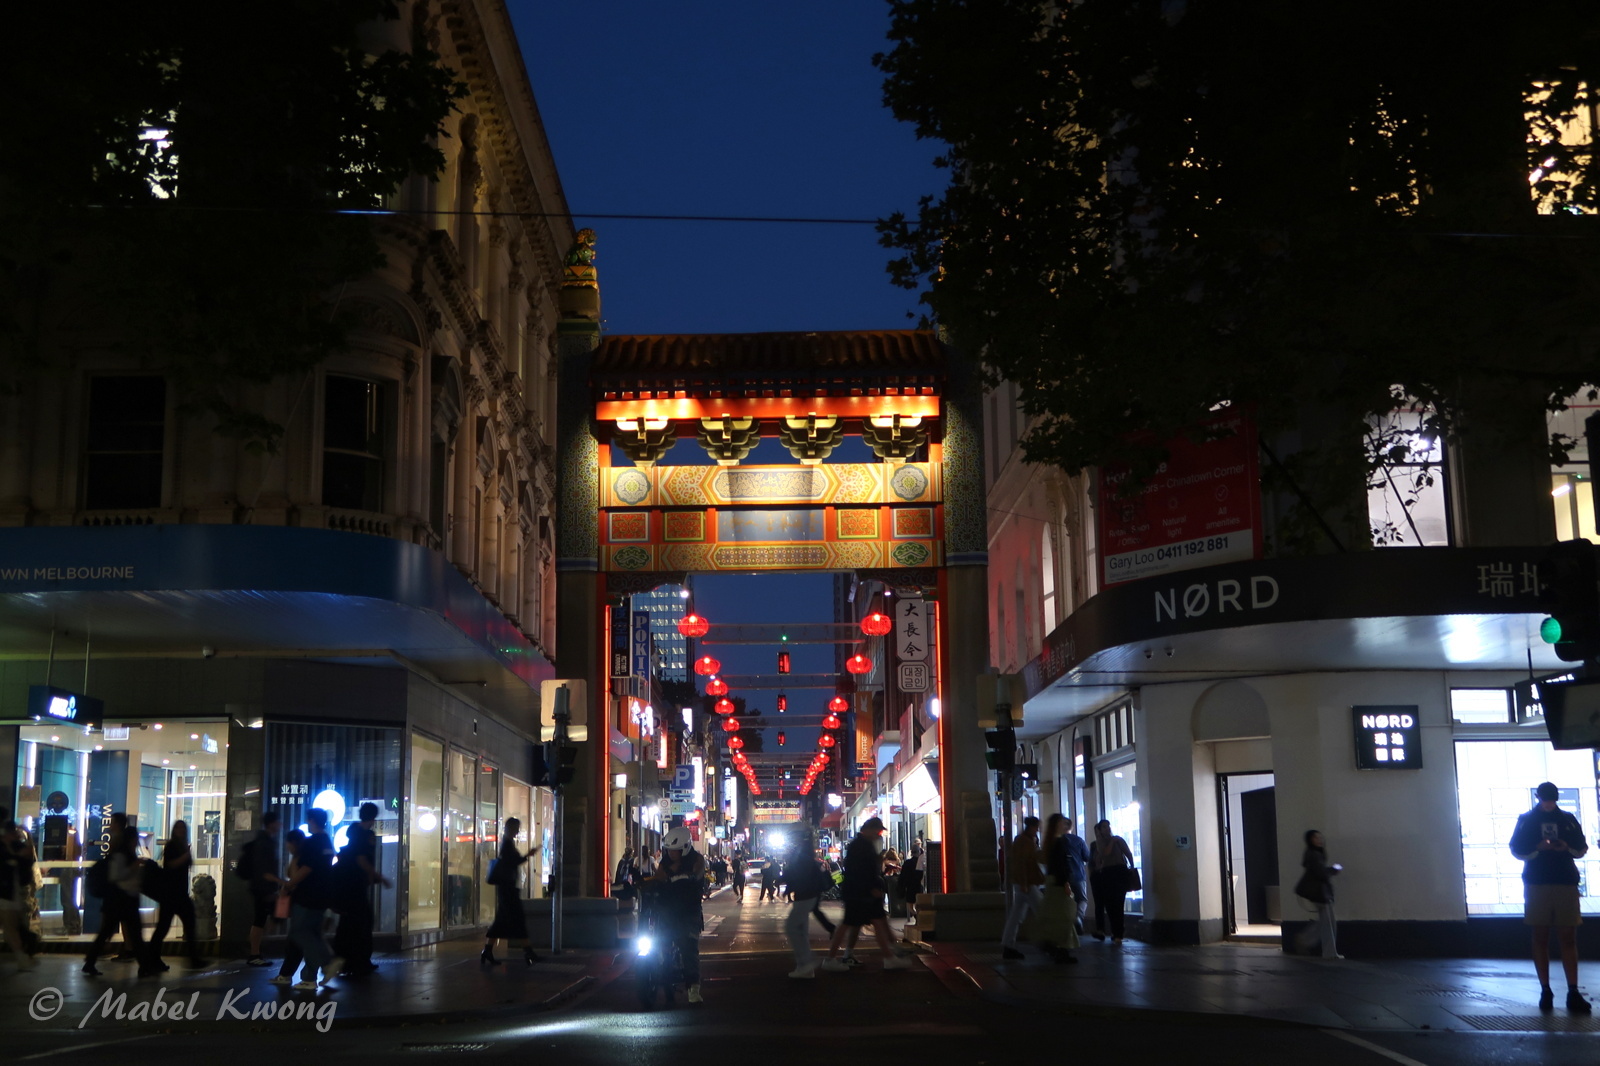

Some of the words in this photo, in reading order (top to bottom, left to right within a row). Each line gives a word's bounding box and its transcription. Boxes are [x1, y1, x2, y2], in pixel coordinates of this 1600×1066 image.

[1166, 471, 1212, 488] Chinatown
[1213, 464, 1245, 478] Corner
[1217, 506, 1228, 516] All
[1162, 515, 1187, 527] Natural
[1206, 516, 1241, 530] amenities
[1167, 527, 1182, 539] light
[1109, 556, 1133, 570] Gary
[1135, 552, 1155, 565] Loo
[1156, 544, 1182, 561] 0411
[1184, 540, 1205, 555] 192
[1206, 536, 1229, 551] 881
[0, 568, 29, 581] WN
[33, 566, 134, 580] MELBOURNE
[903, 603, 922, 657] 大長今
[904, 667, 923, 677] 대장
[860, 736, 868, 761] home
[675, 767, 691, 787] P
[100, 803, 113, 860] WELCO
